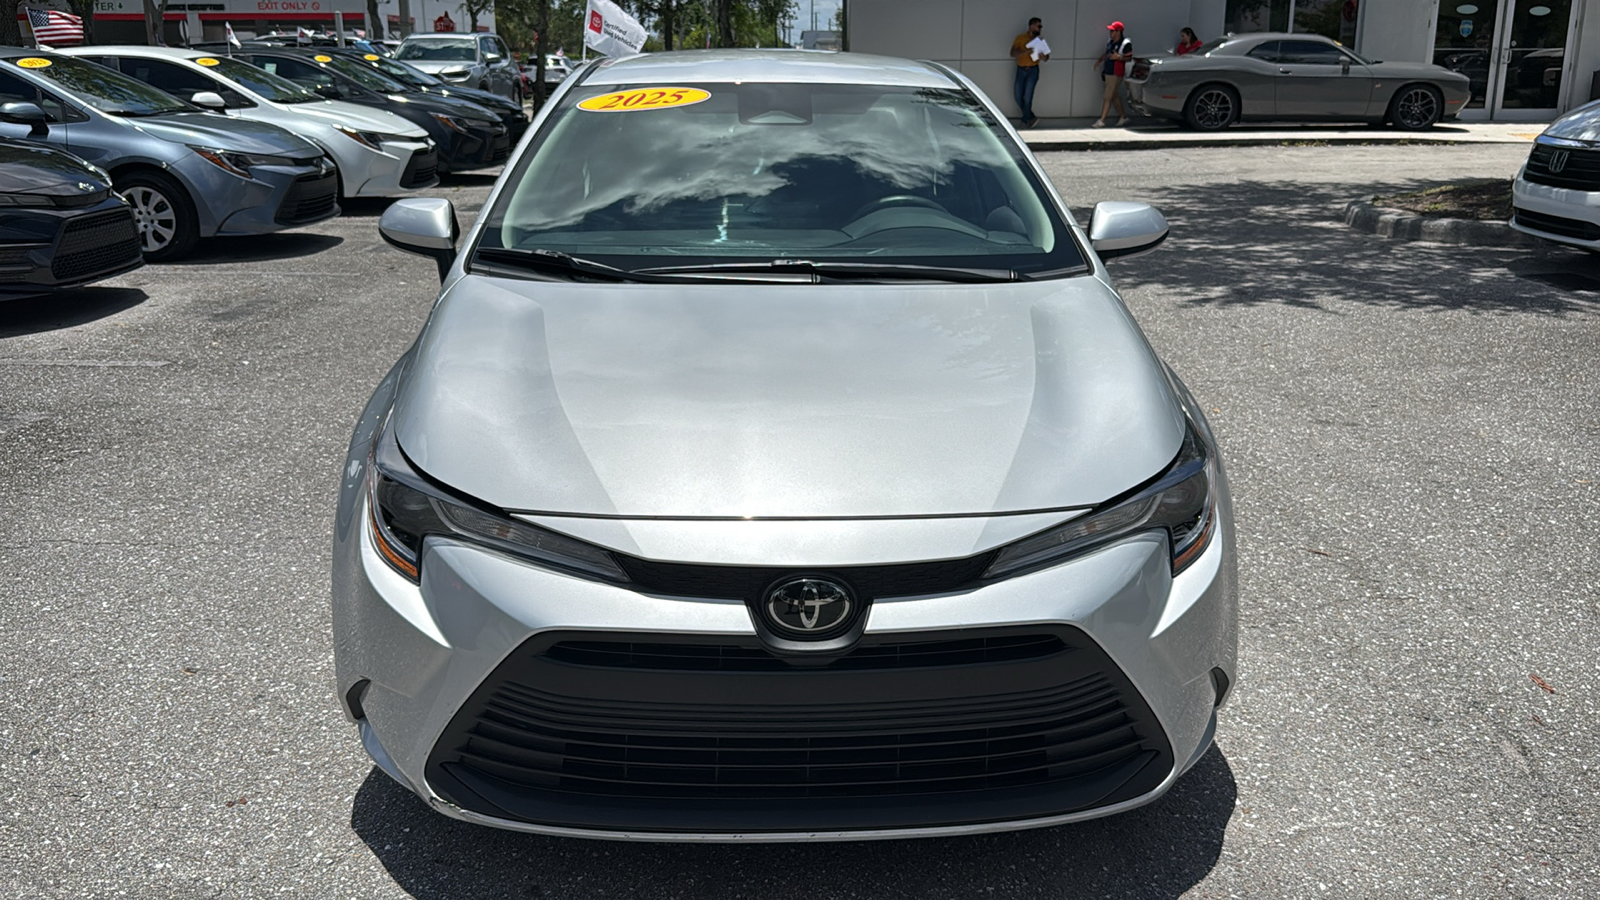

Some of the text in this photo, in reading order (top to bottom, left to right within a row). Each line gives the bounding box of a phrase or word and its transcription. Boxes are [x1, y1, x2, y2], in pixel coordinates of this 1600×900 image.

[258, 2, 307, 10] EXIT ONLY
[604, 20, 628, 35] Certified
[614, 33, 638, 50] Vehicles
[597, 90, 691, 110] 2025
